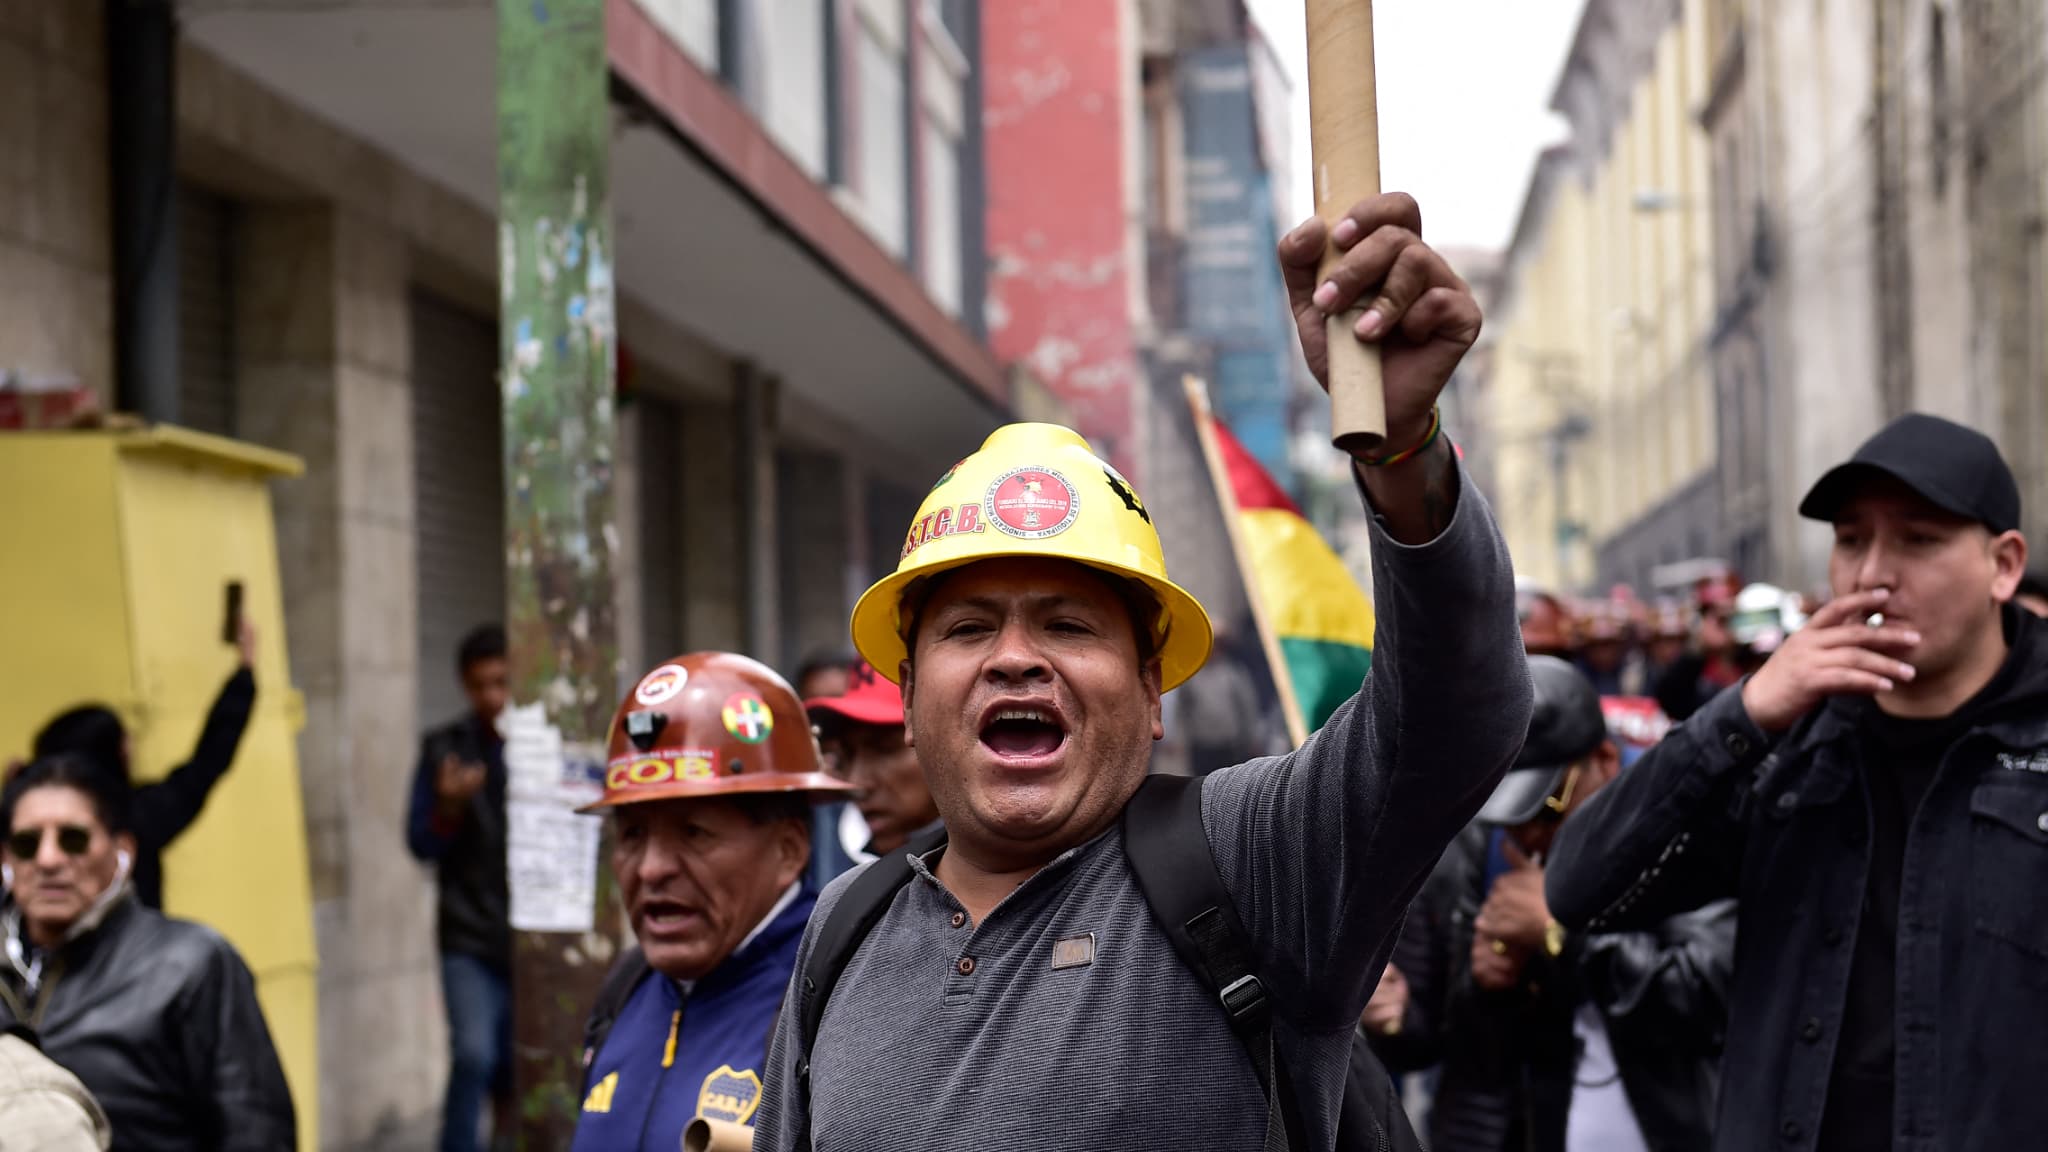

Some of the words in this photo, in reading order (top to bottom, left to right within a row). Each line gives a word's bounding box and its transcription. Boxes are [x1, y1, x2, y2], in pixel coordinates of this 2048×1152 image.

[1051, 471, 1078, 508] MUNICIPALES
[992, 516, 1026, 537] SINDICATO
[1037, 518, 1072, 537] TIQUIPAYA
[607, 757, 713, 790] COB
